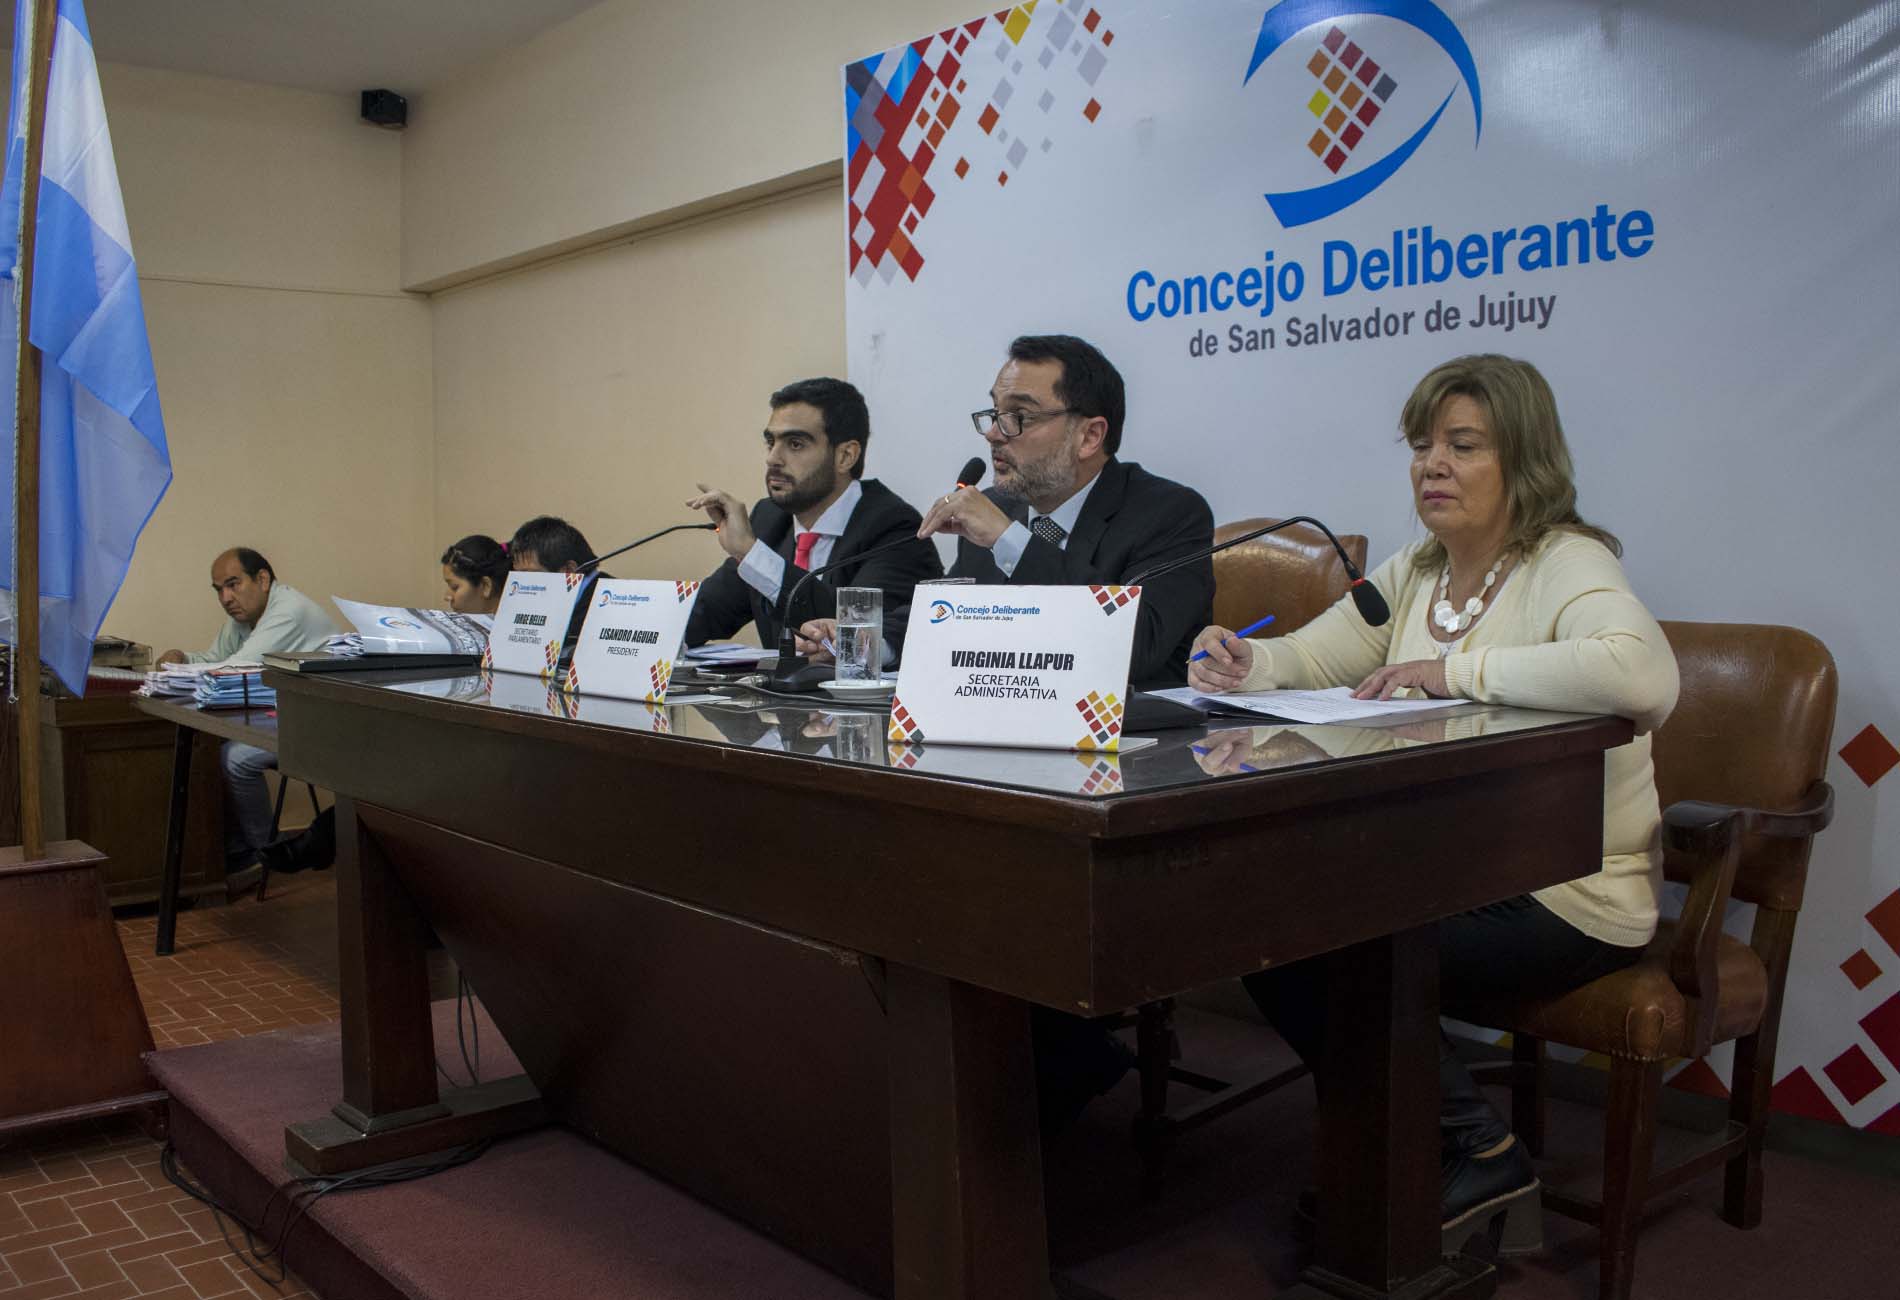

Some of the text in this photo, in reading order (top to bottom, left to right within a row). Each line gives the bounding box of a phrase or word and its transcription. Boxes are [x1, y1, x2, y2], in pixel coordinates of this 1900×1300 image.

[1127, 204, 1654, 322] Concejo Deliberante
[1189, 291, 1557, 358] de San Salvador de Jujuy
[957, 604, 1040, 615] Concejo Deliberante
[599, 627, 659, 644] LISANDRO AGUIAR
[607, 646, 640, 656] PRESIDENTE
[951, 650, 1075, 671] VIRGINIA LLAPUR
[968, 673, 1040, 687] SECRETARIA
[954, 686, 1057, 700] ADMINISTRATIVA
